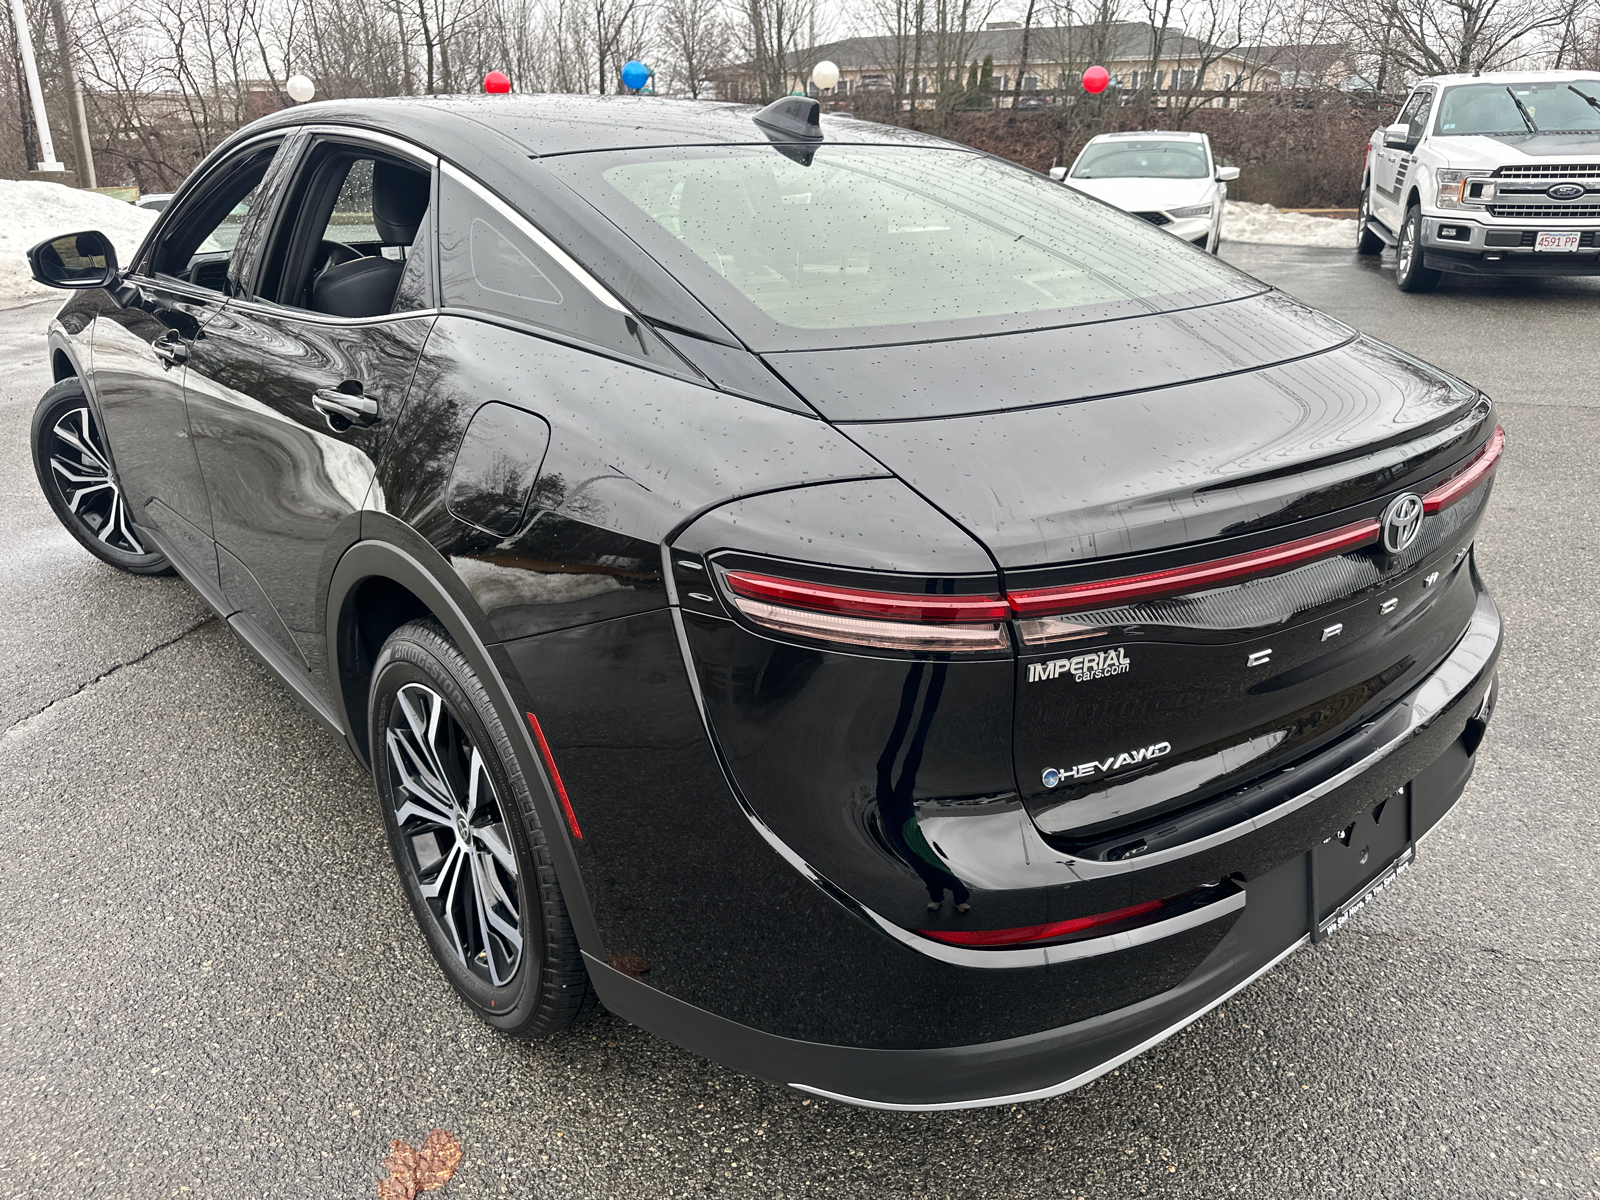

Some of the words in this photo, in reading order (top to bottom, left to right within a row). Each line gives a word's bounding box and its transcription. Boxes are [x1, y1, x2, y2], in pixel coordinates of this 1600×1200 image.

[1538, 237, 1561, 247] 4591
[1564, 237, 1577, 247] PP
[1027, 647, 1130, 682] IMPERIAL
[1075, 663, 1130, 682] cars.com
[395, 645, 470, 714] BRIDGESTONE
